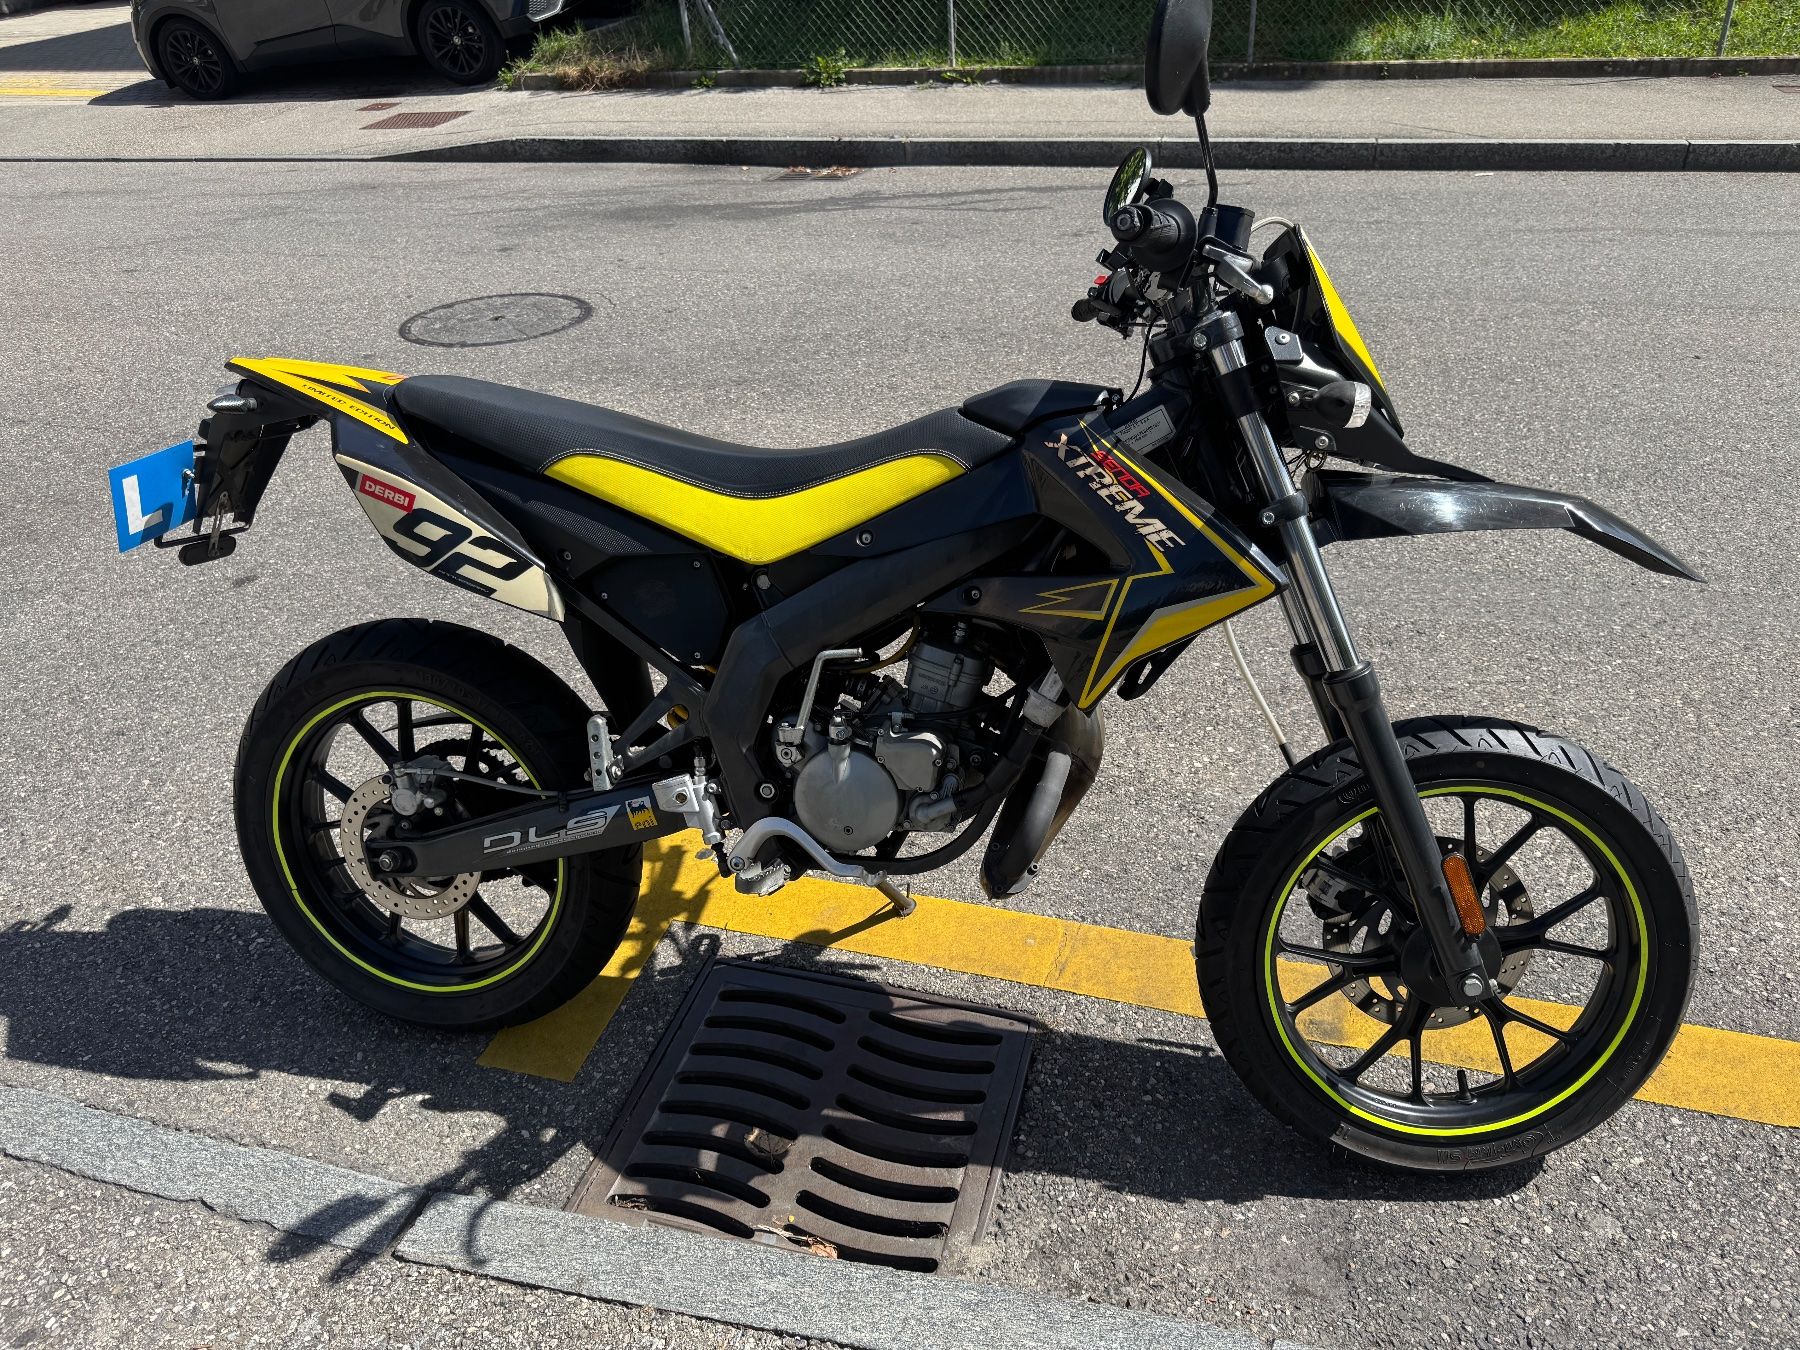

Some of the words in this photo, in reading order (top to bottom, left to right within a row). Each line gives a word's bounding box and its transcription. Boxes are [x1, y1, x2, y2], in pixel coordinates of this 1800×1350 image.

[301, 383, 347, 405] LIMITED
[349, 404, 396, 430] EDITION
[121, 474, 164, 536] L
[364, 480, 410, 507] DERBI
[1043, 432, 1187, 552] XTREME
[382, 508, 535, 597] 92
[483, 808, 612, 854] DLS
